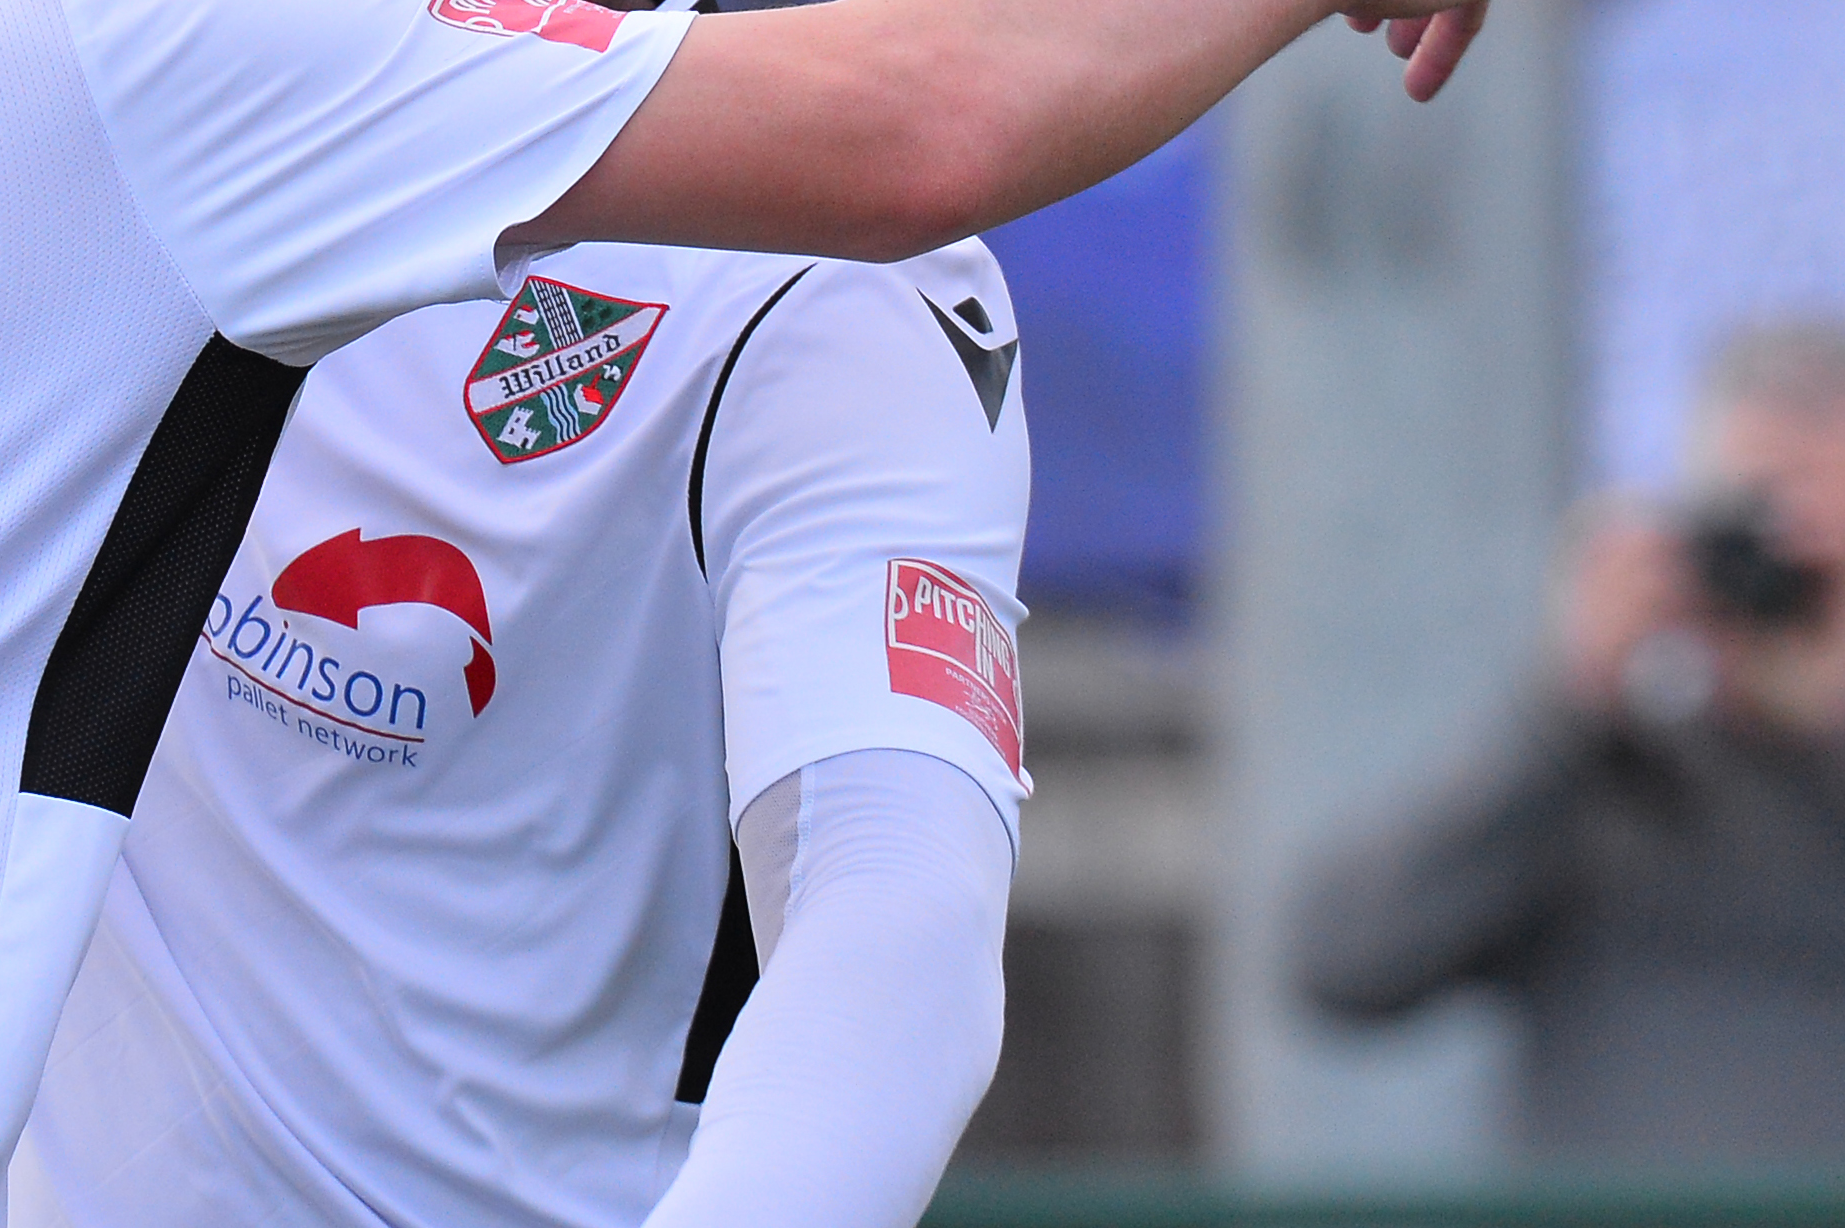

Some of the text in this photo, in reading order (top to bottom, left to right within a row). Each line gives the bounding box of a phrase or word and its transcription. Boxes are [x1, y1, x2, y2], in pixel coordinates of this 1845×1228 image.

[498, 333, 621, 399] Willand
[205, 592, 427, 730] obinson
[227, 674, 418, 768] pallet network
